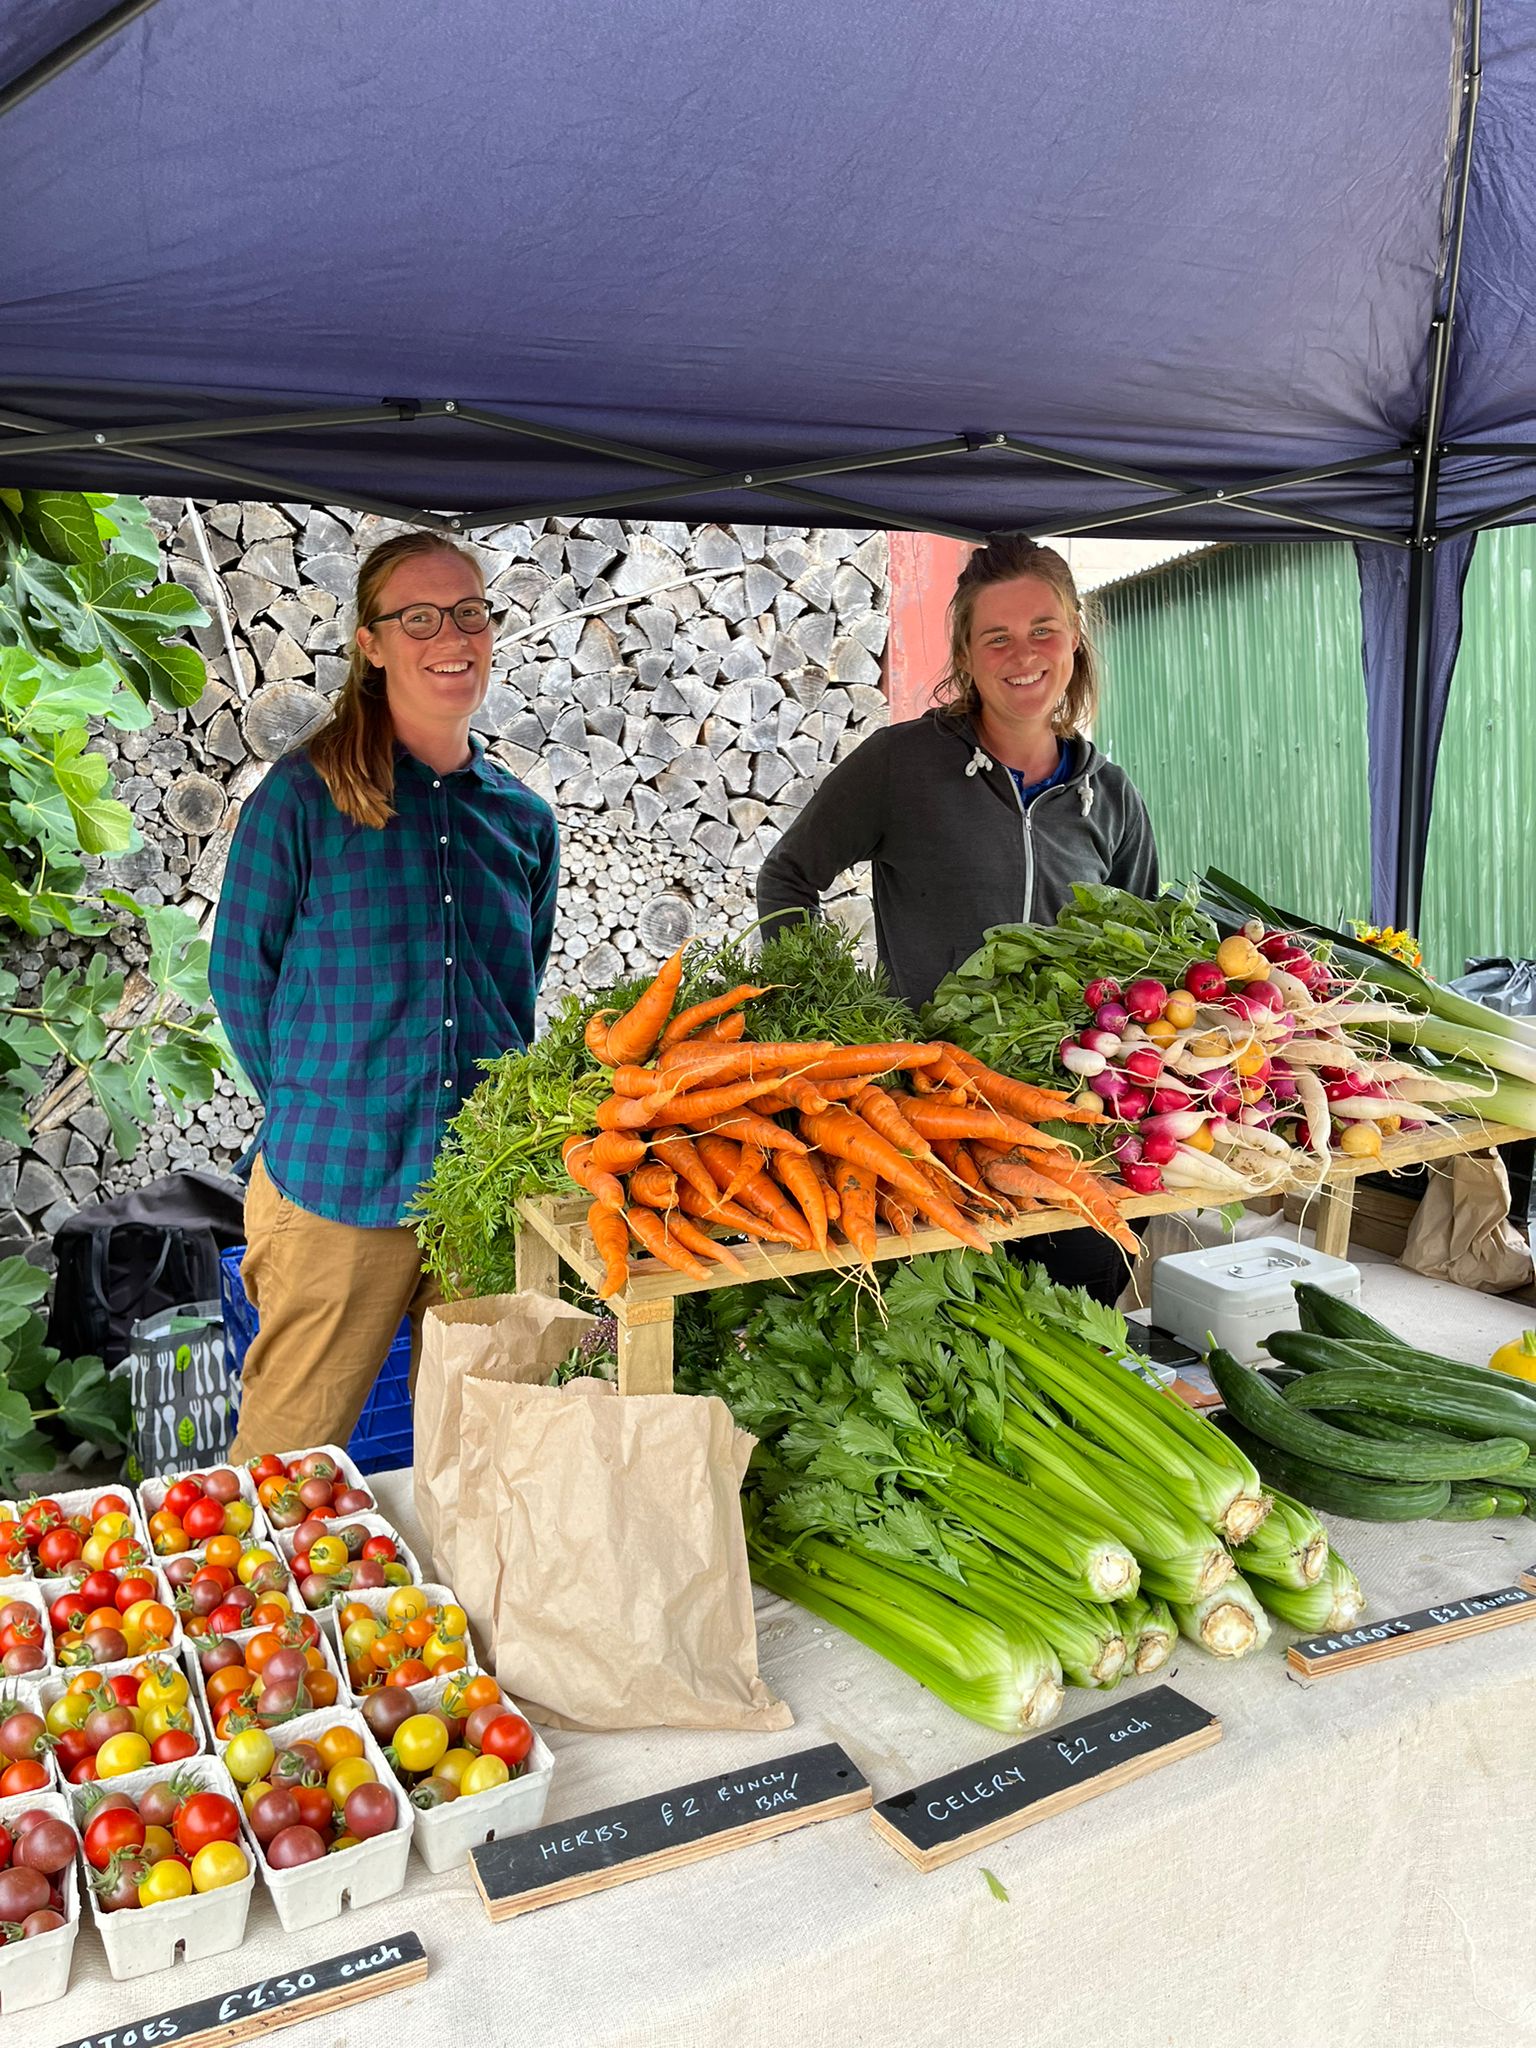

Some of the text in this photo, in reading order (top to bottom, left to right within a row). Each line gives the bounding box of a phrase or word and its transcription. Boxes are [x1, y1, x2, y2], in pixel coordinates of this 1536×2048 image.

[1308, 1620, 1411, 1655] CARROTS
[927, 1717, 1152, 1821] CELERY £2 each
[756, 1789, 798, 1811] BAG
[540, 1823, 628, 1859] HERBS
[340, 1945, 402, 1977] each
